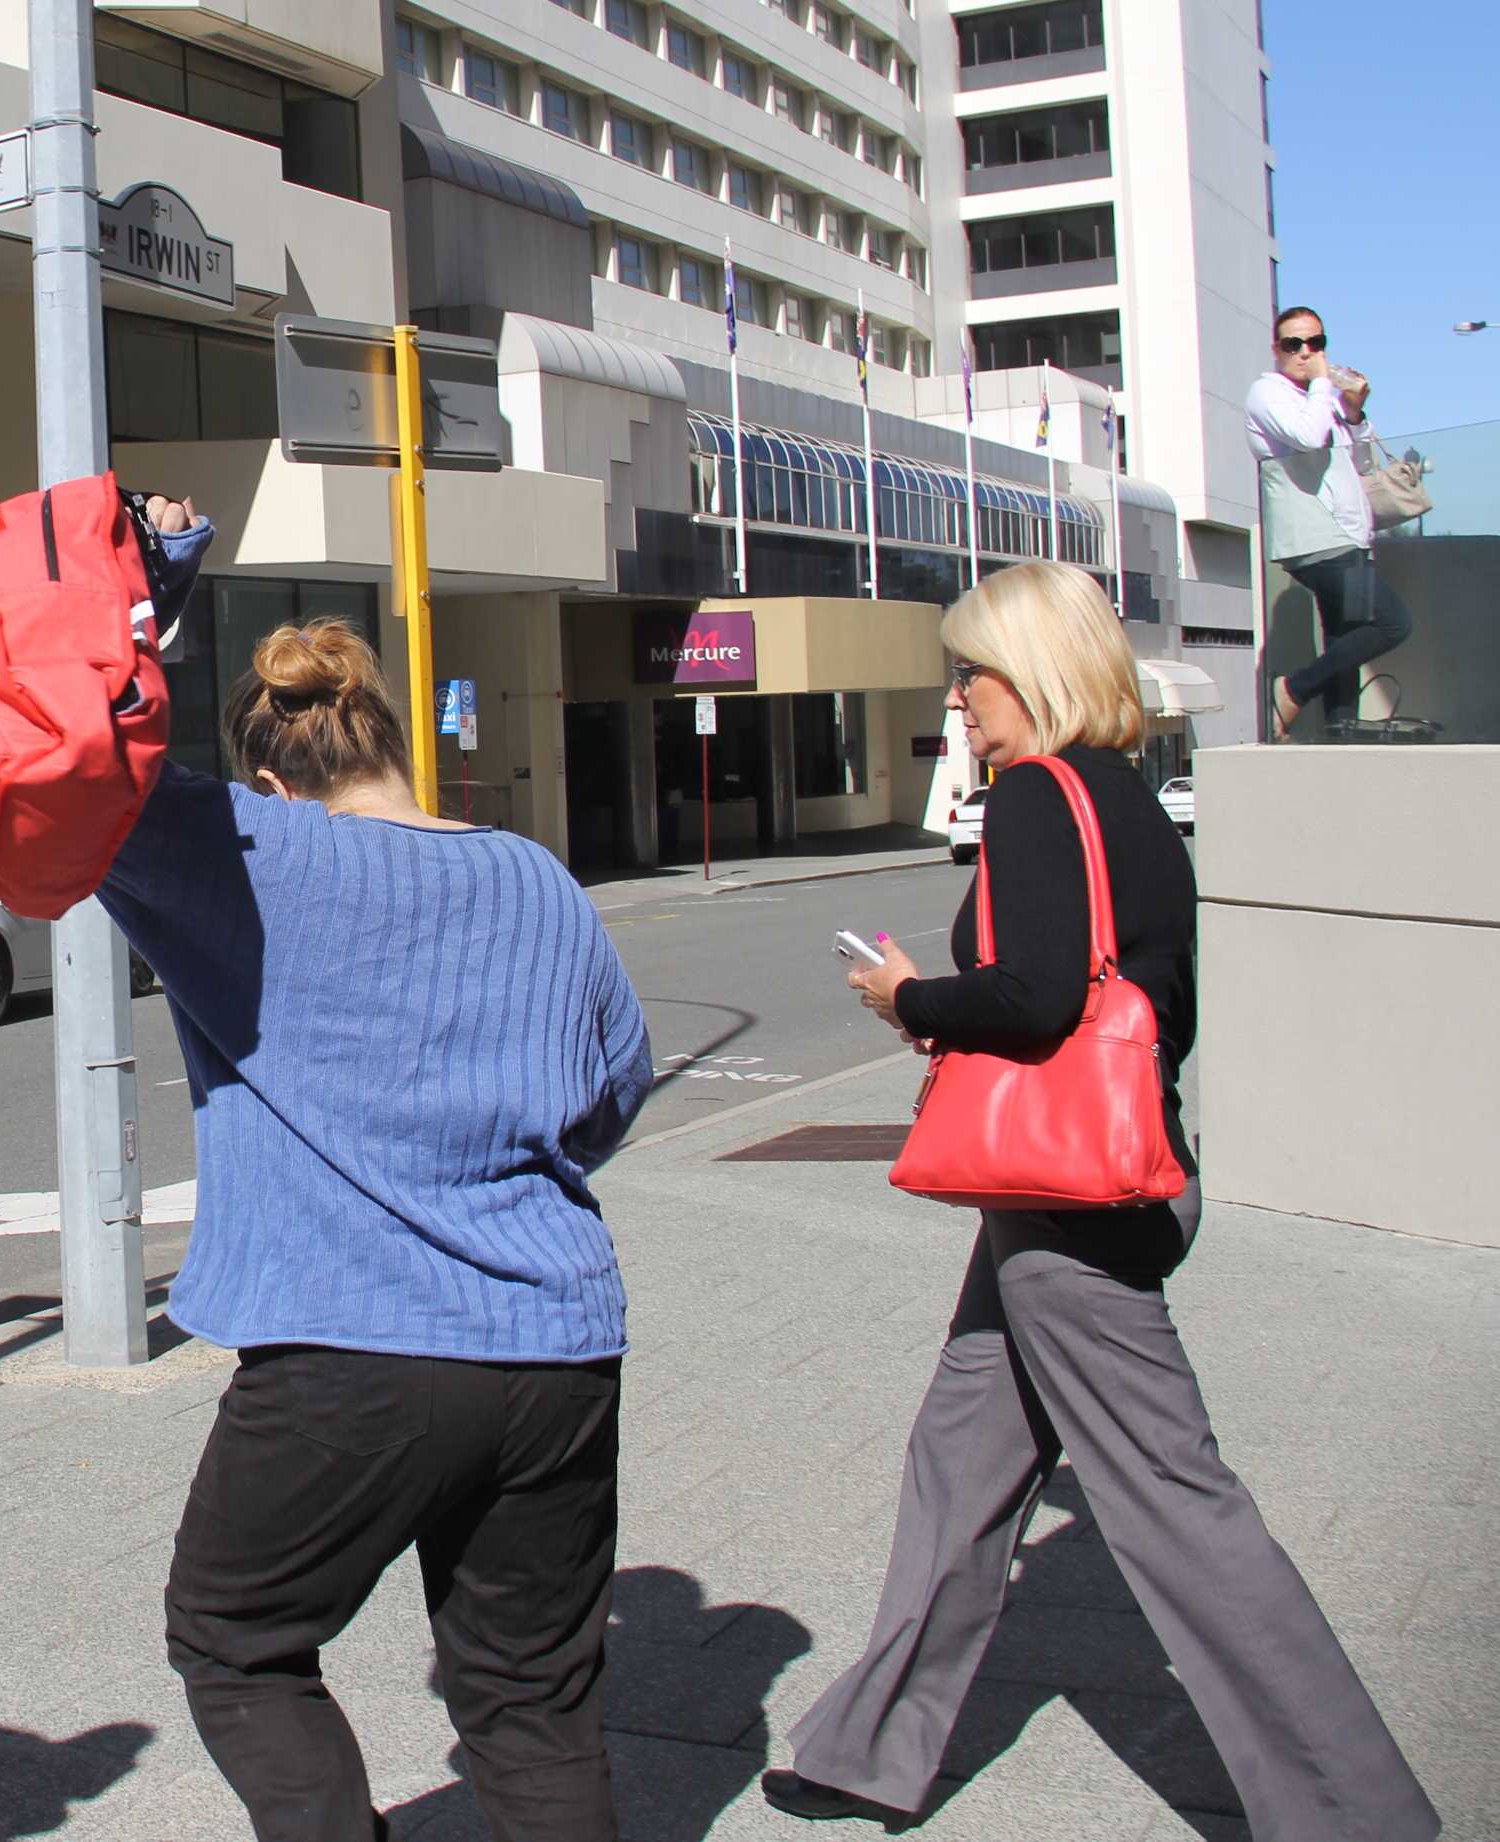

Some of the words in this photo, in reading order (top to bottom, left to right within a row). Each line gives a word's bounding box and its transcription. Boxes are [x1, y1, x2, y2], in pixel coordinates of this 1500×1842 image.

[128, 224, 201, 284] IRWIN
[205, 249, 221, 275] ST
[650, 646, 741, 662] Mercure
[661, 1053, 765, 1065] NO
